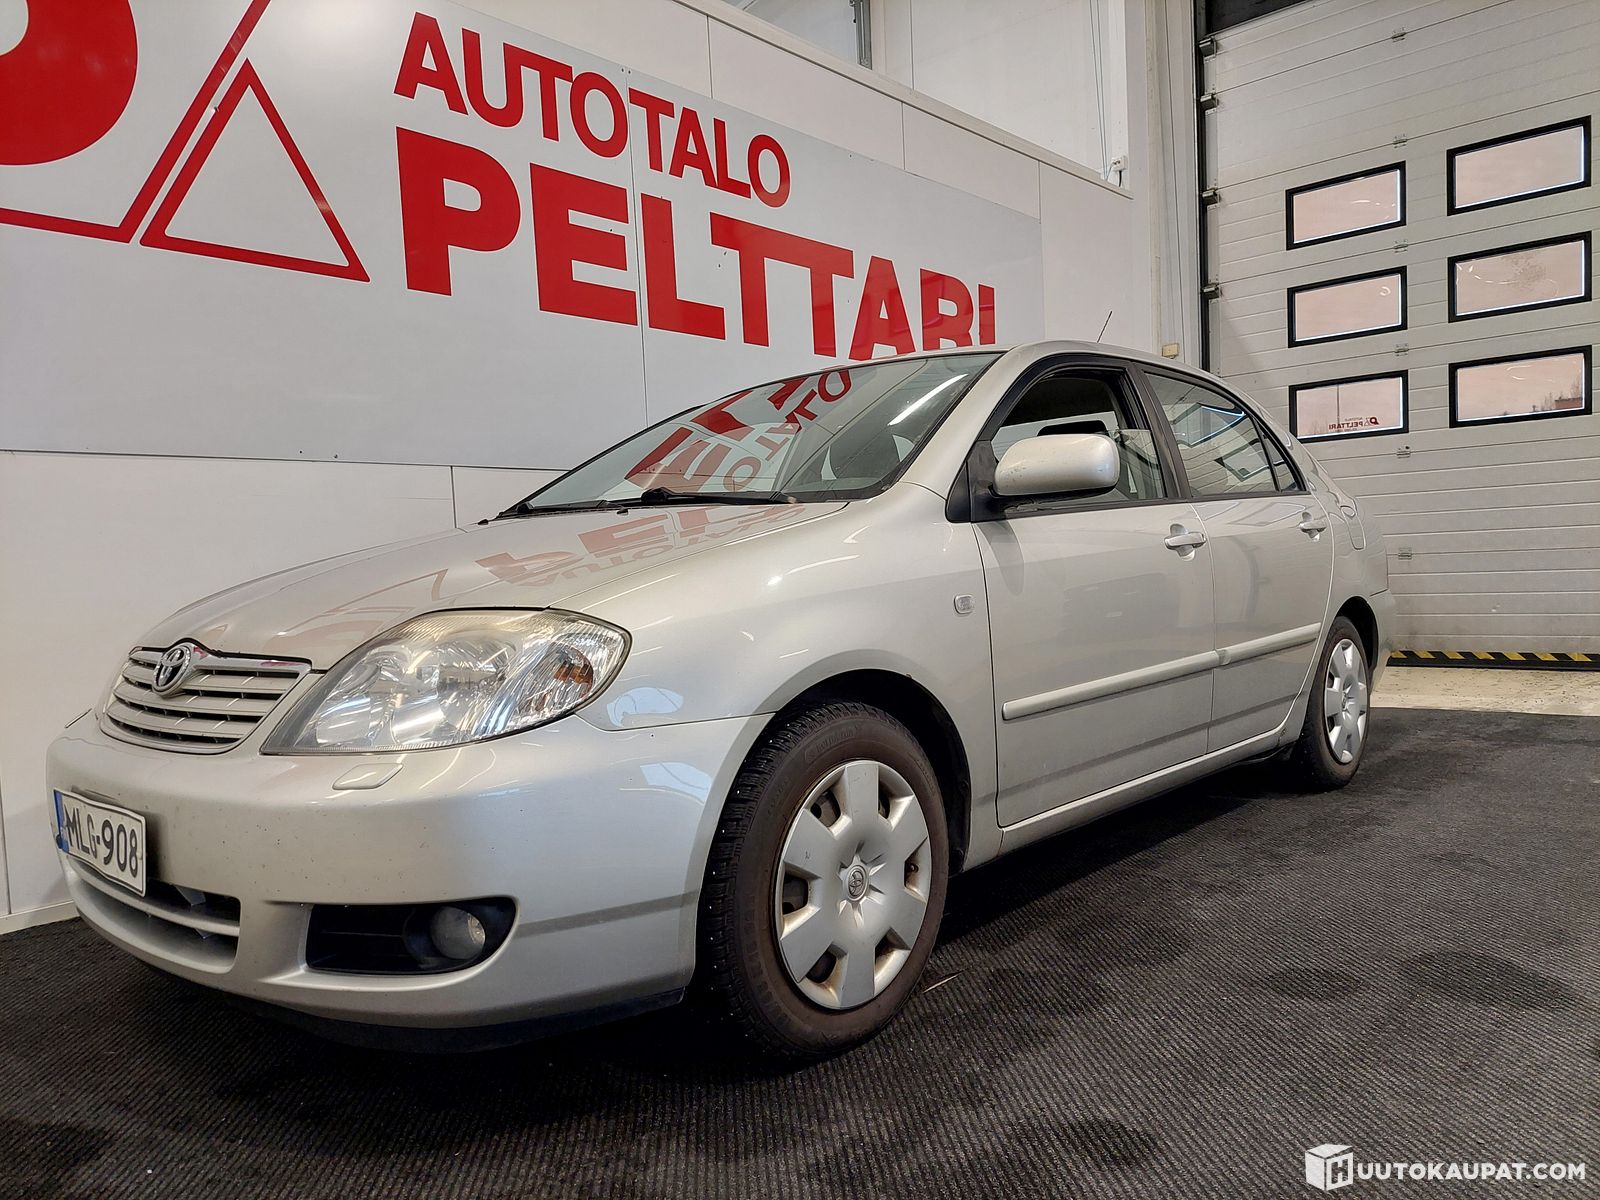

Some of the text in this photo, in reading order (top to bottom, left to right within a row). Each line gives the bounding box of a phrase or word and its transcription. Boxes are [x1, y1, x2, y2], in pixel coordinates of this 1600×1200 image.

[394, 11, 790, 208] AUTOTALO
[395, 126, 996, 360] PELTTARI
[63, 803, 139, 878] MLG-908
